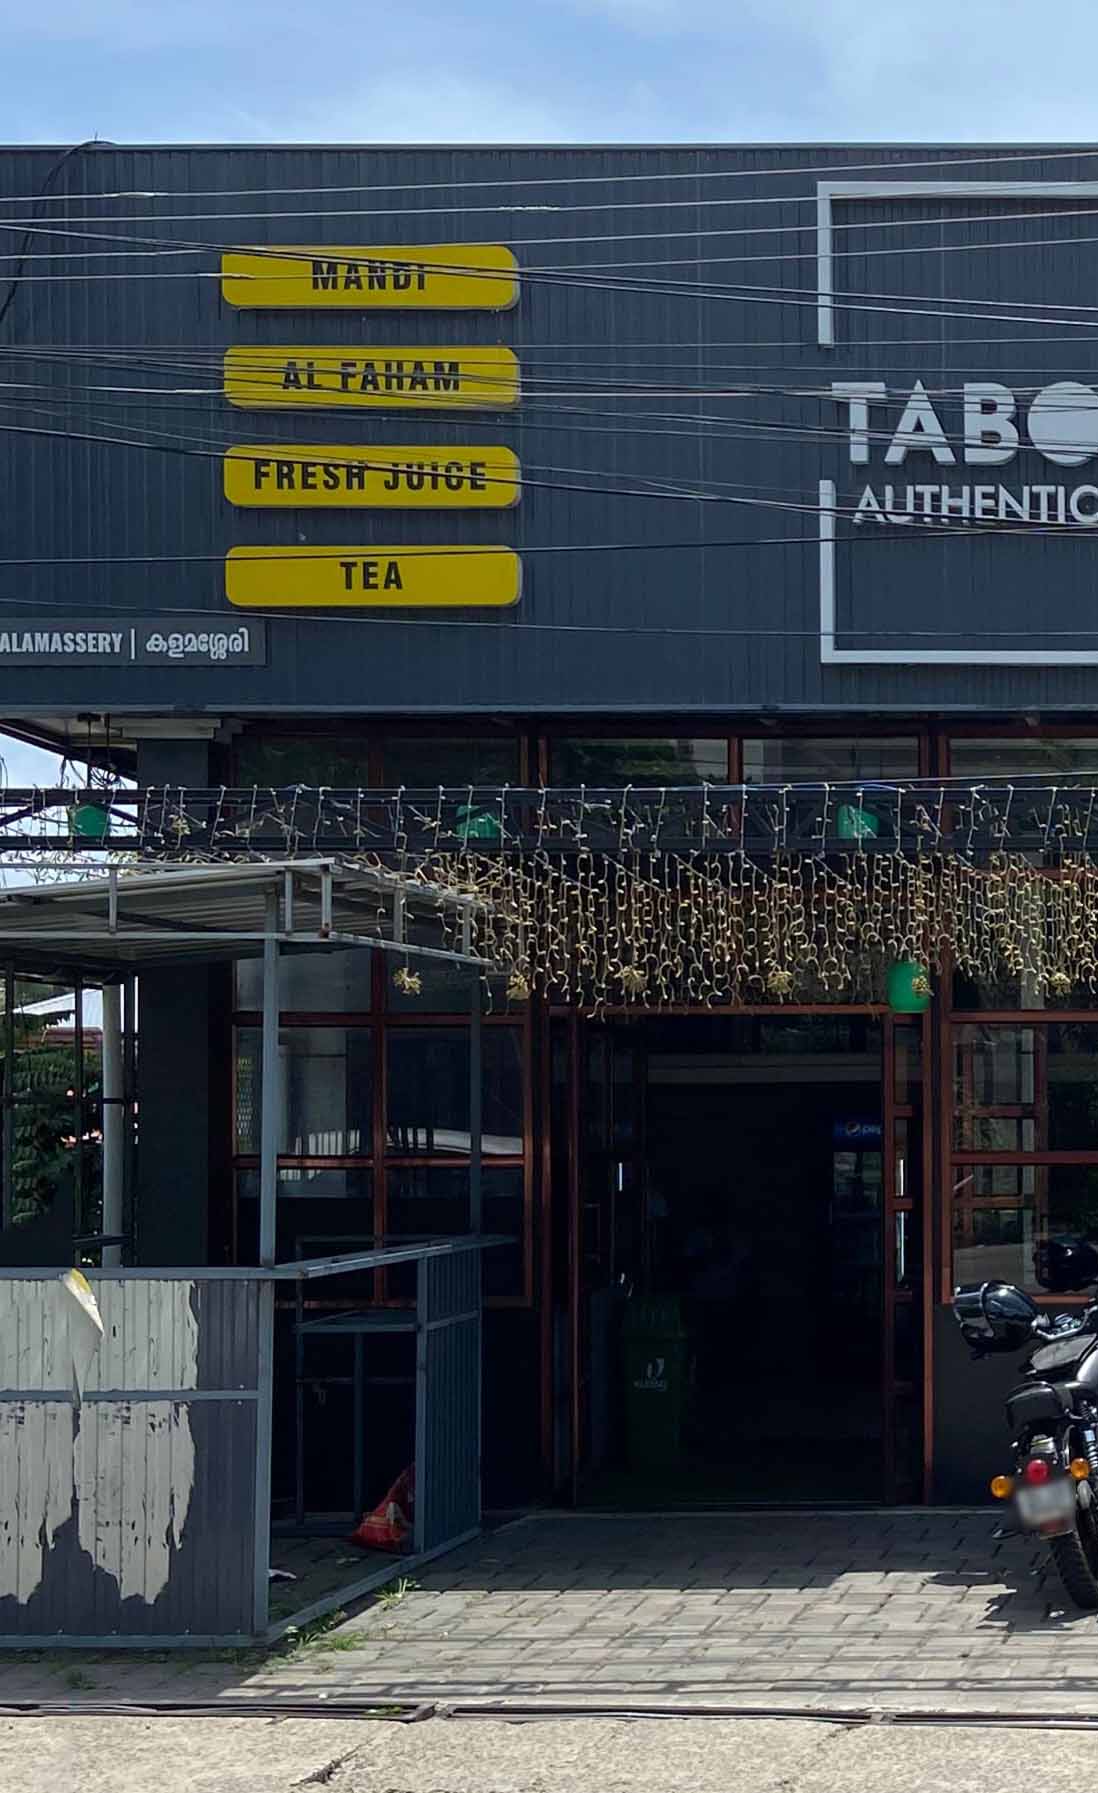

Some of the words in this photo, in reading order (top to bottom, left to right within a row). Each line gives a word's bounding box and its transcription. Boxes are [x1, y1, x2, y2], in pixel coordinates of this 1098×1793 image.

[312, 259, 425, 290] MANDI
[282, 361, 321, 390] AL
[341, 361, 460, 391] FAHAM
[254, 460, 368, 490] FRESH
[384, 461, 487, 490] JUICE
[339, 561, 404, 590] TEA
